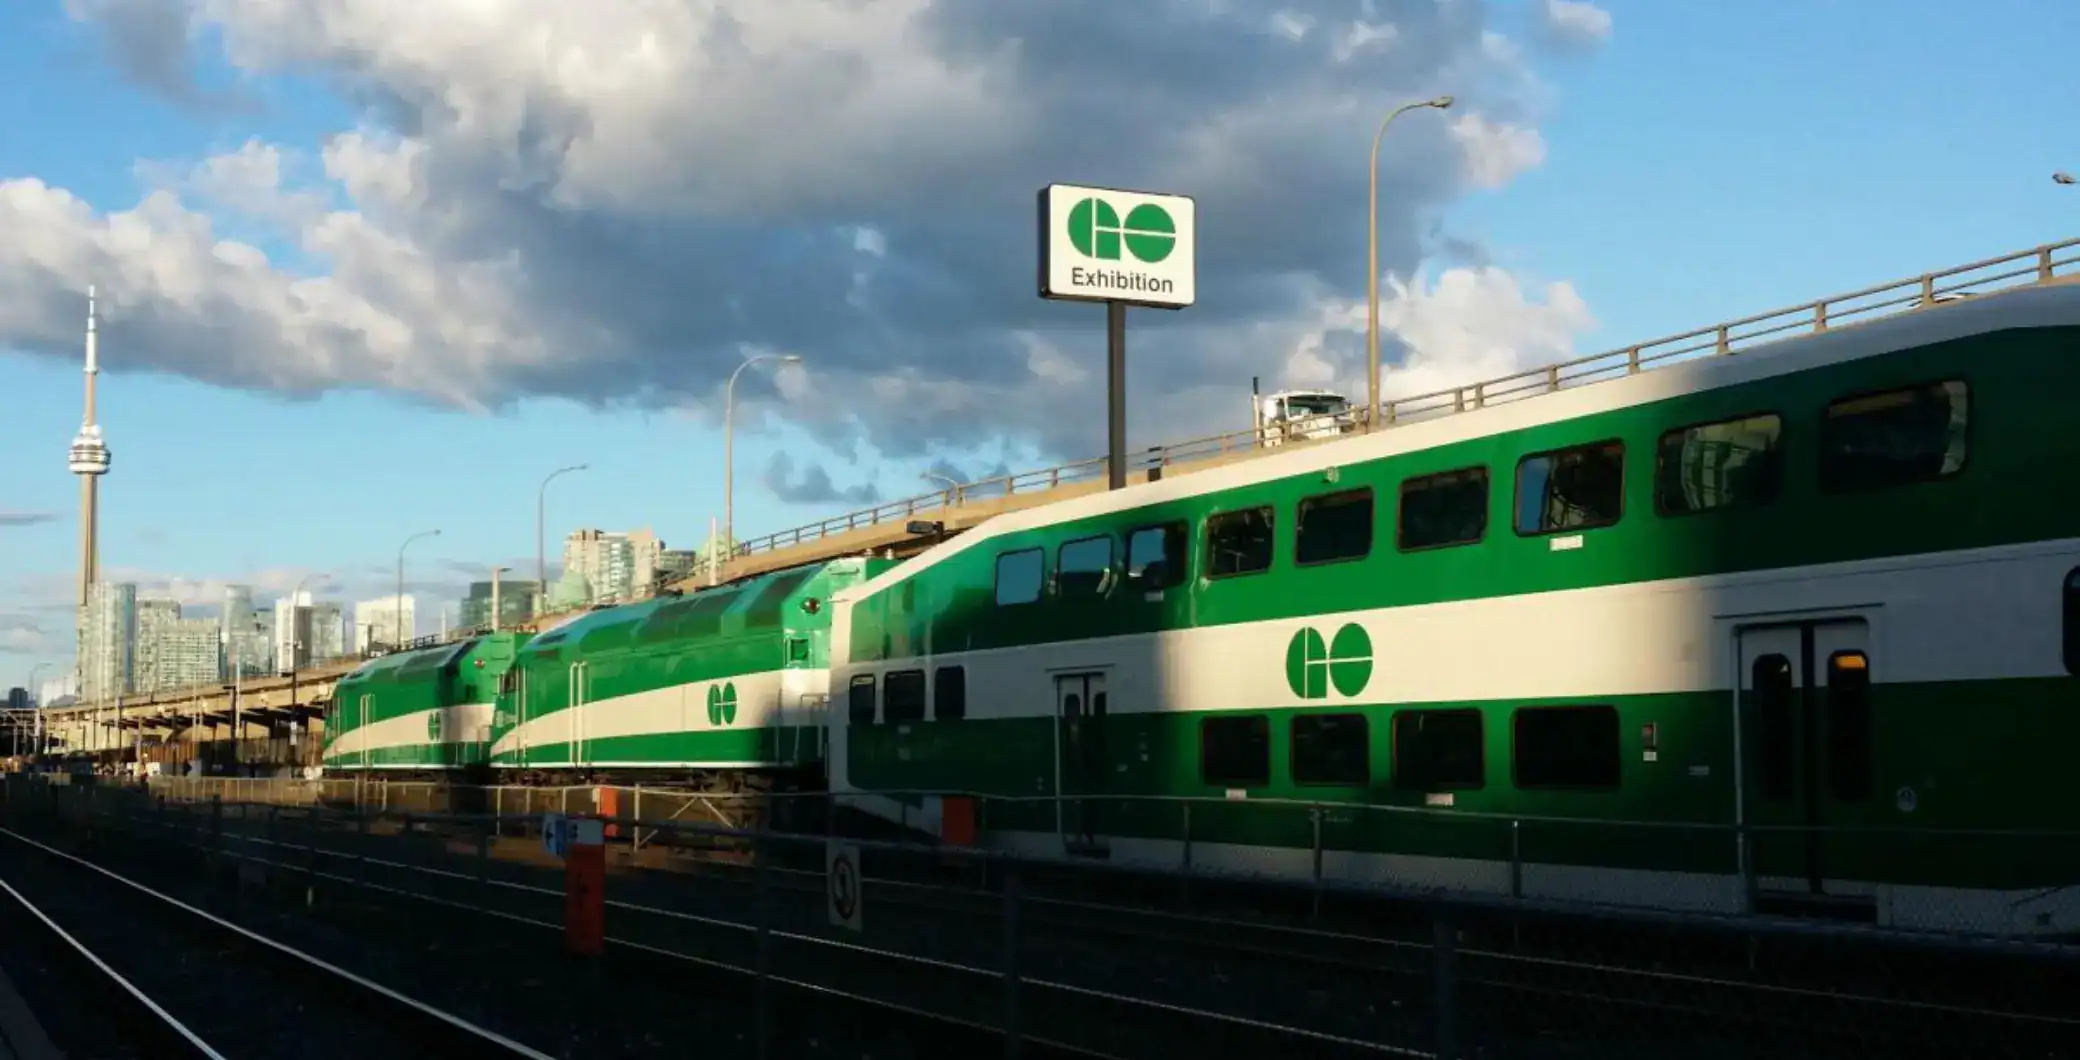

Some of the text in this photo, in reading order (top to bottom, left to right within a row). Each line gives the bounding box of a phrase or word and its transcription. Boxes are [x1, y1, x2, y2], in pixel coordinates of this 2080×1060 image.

[1067, 197, 1176, 264] GO
[1071, 266, 1174, 294] Exhibition
[1286, 622, 1373, 700] GO
[707, 681, 738, 726] GO
